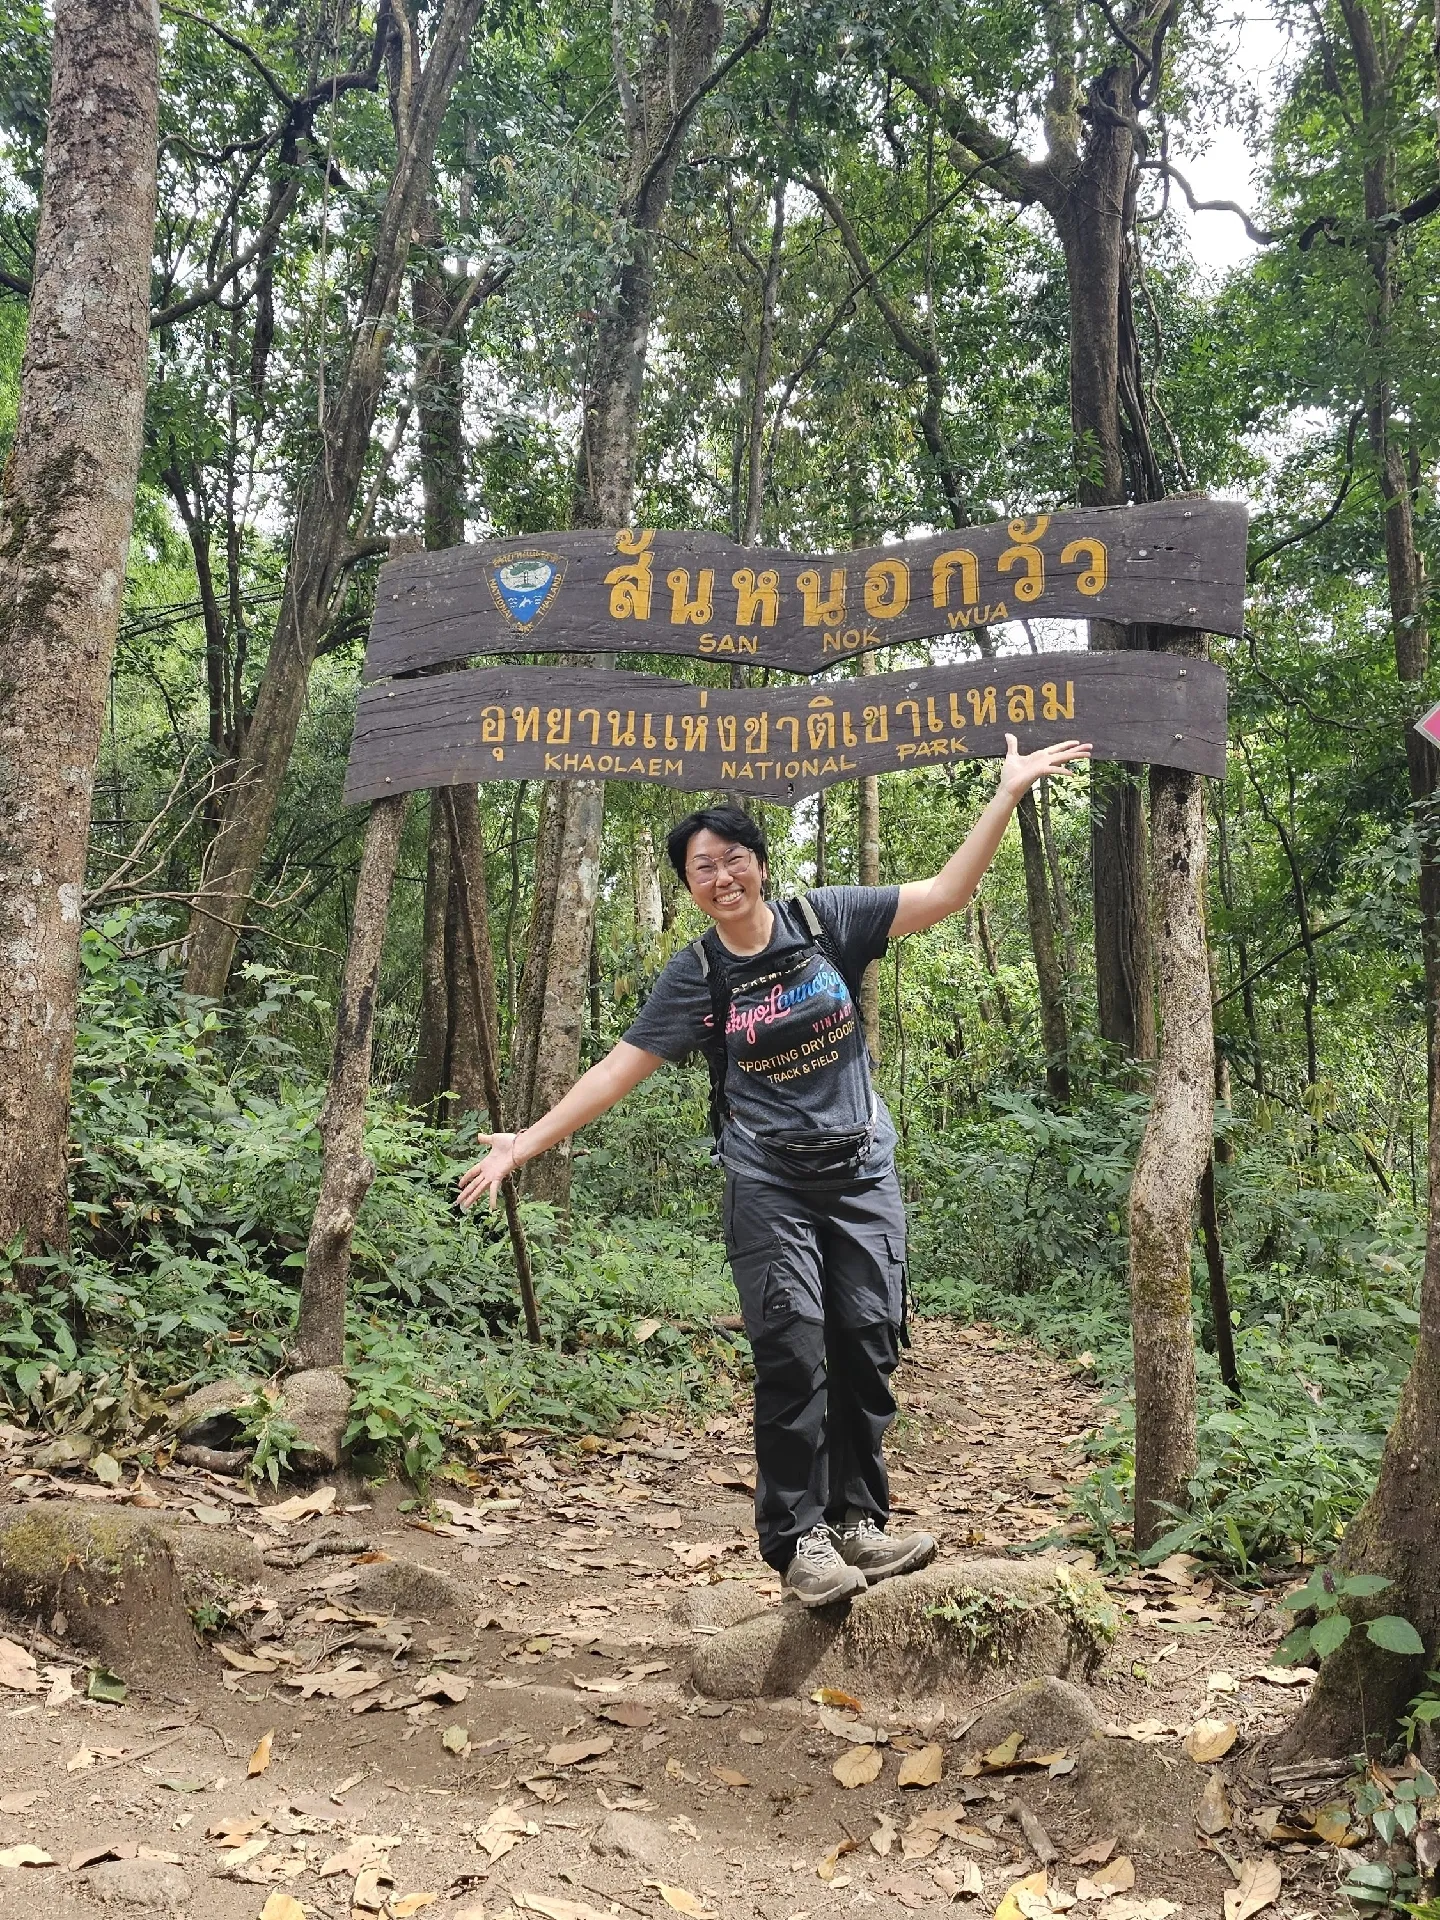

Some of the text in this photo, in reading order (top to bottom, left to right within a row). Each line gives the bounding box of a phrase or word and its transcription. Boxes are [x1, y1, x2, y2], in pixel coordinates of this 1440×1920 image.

[604, 516, 1107, 627] สันหนอกวัว
[536, 573, 562, 616] THAILAND
[698, 602, 1009, 655] SAN NOK WUA
[480, 680, 1075, 762] อุทยานแห่งชาติเขาแหลม
[544, 736, 969, 781] KHAOLAEM NATIONAL PARK
[737, 1049, 799, 1073] SPORTING
[800, 1036, 825, 1056] DRY
[767, 1050, 839, 1084] TRACK & FIELD
